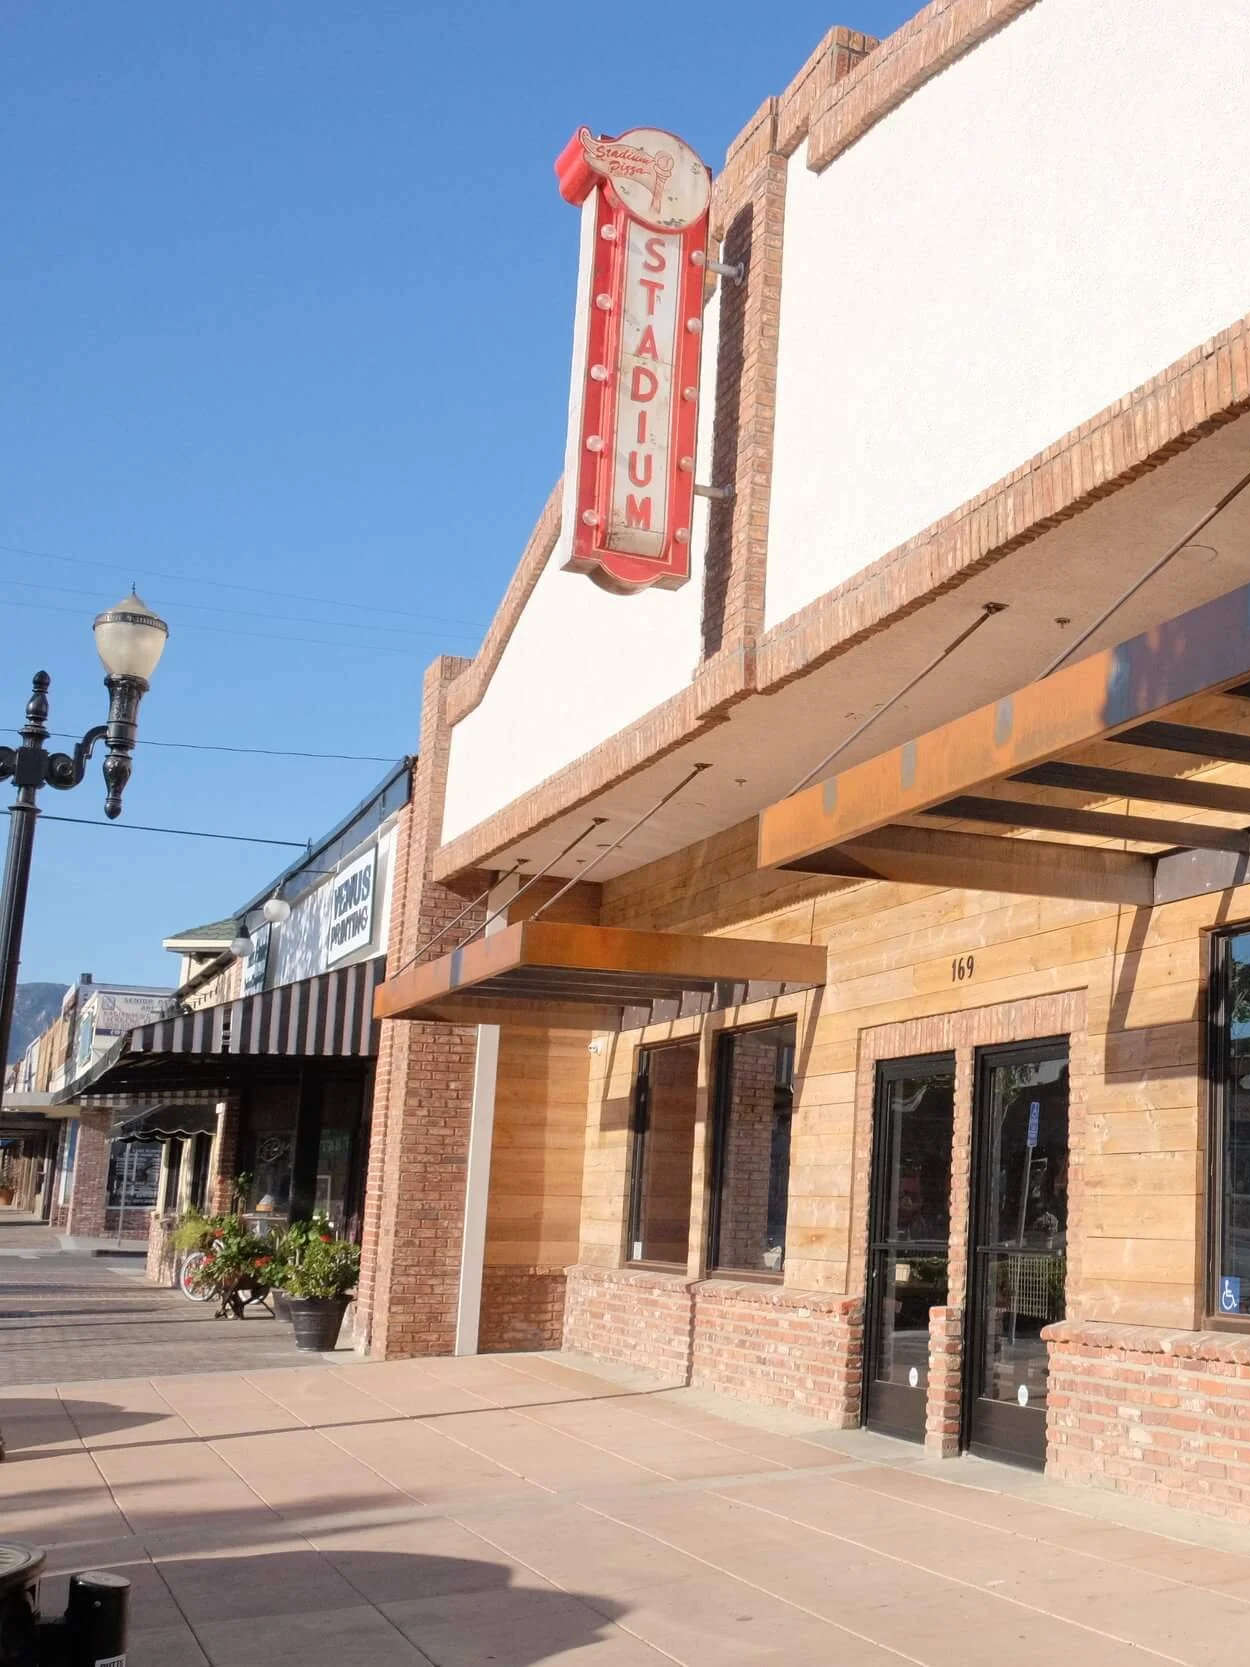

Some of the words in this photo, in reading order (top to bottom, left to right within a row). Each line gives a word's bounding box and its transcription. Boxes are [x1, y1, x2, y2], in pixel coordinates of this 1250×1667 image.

[596, 145, 651, 164] Stadium
[608, 160, 651, 176] Pizza
[625, 237, 667, 531] STADIUM
[329, 905, 368, 952] PRINTING
[951, 955, 975, 983] 169
